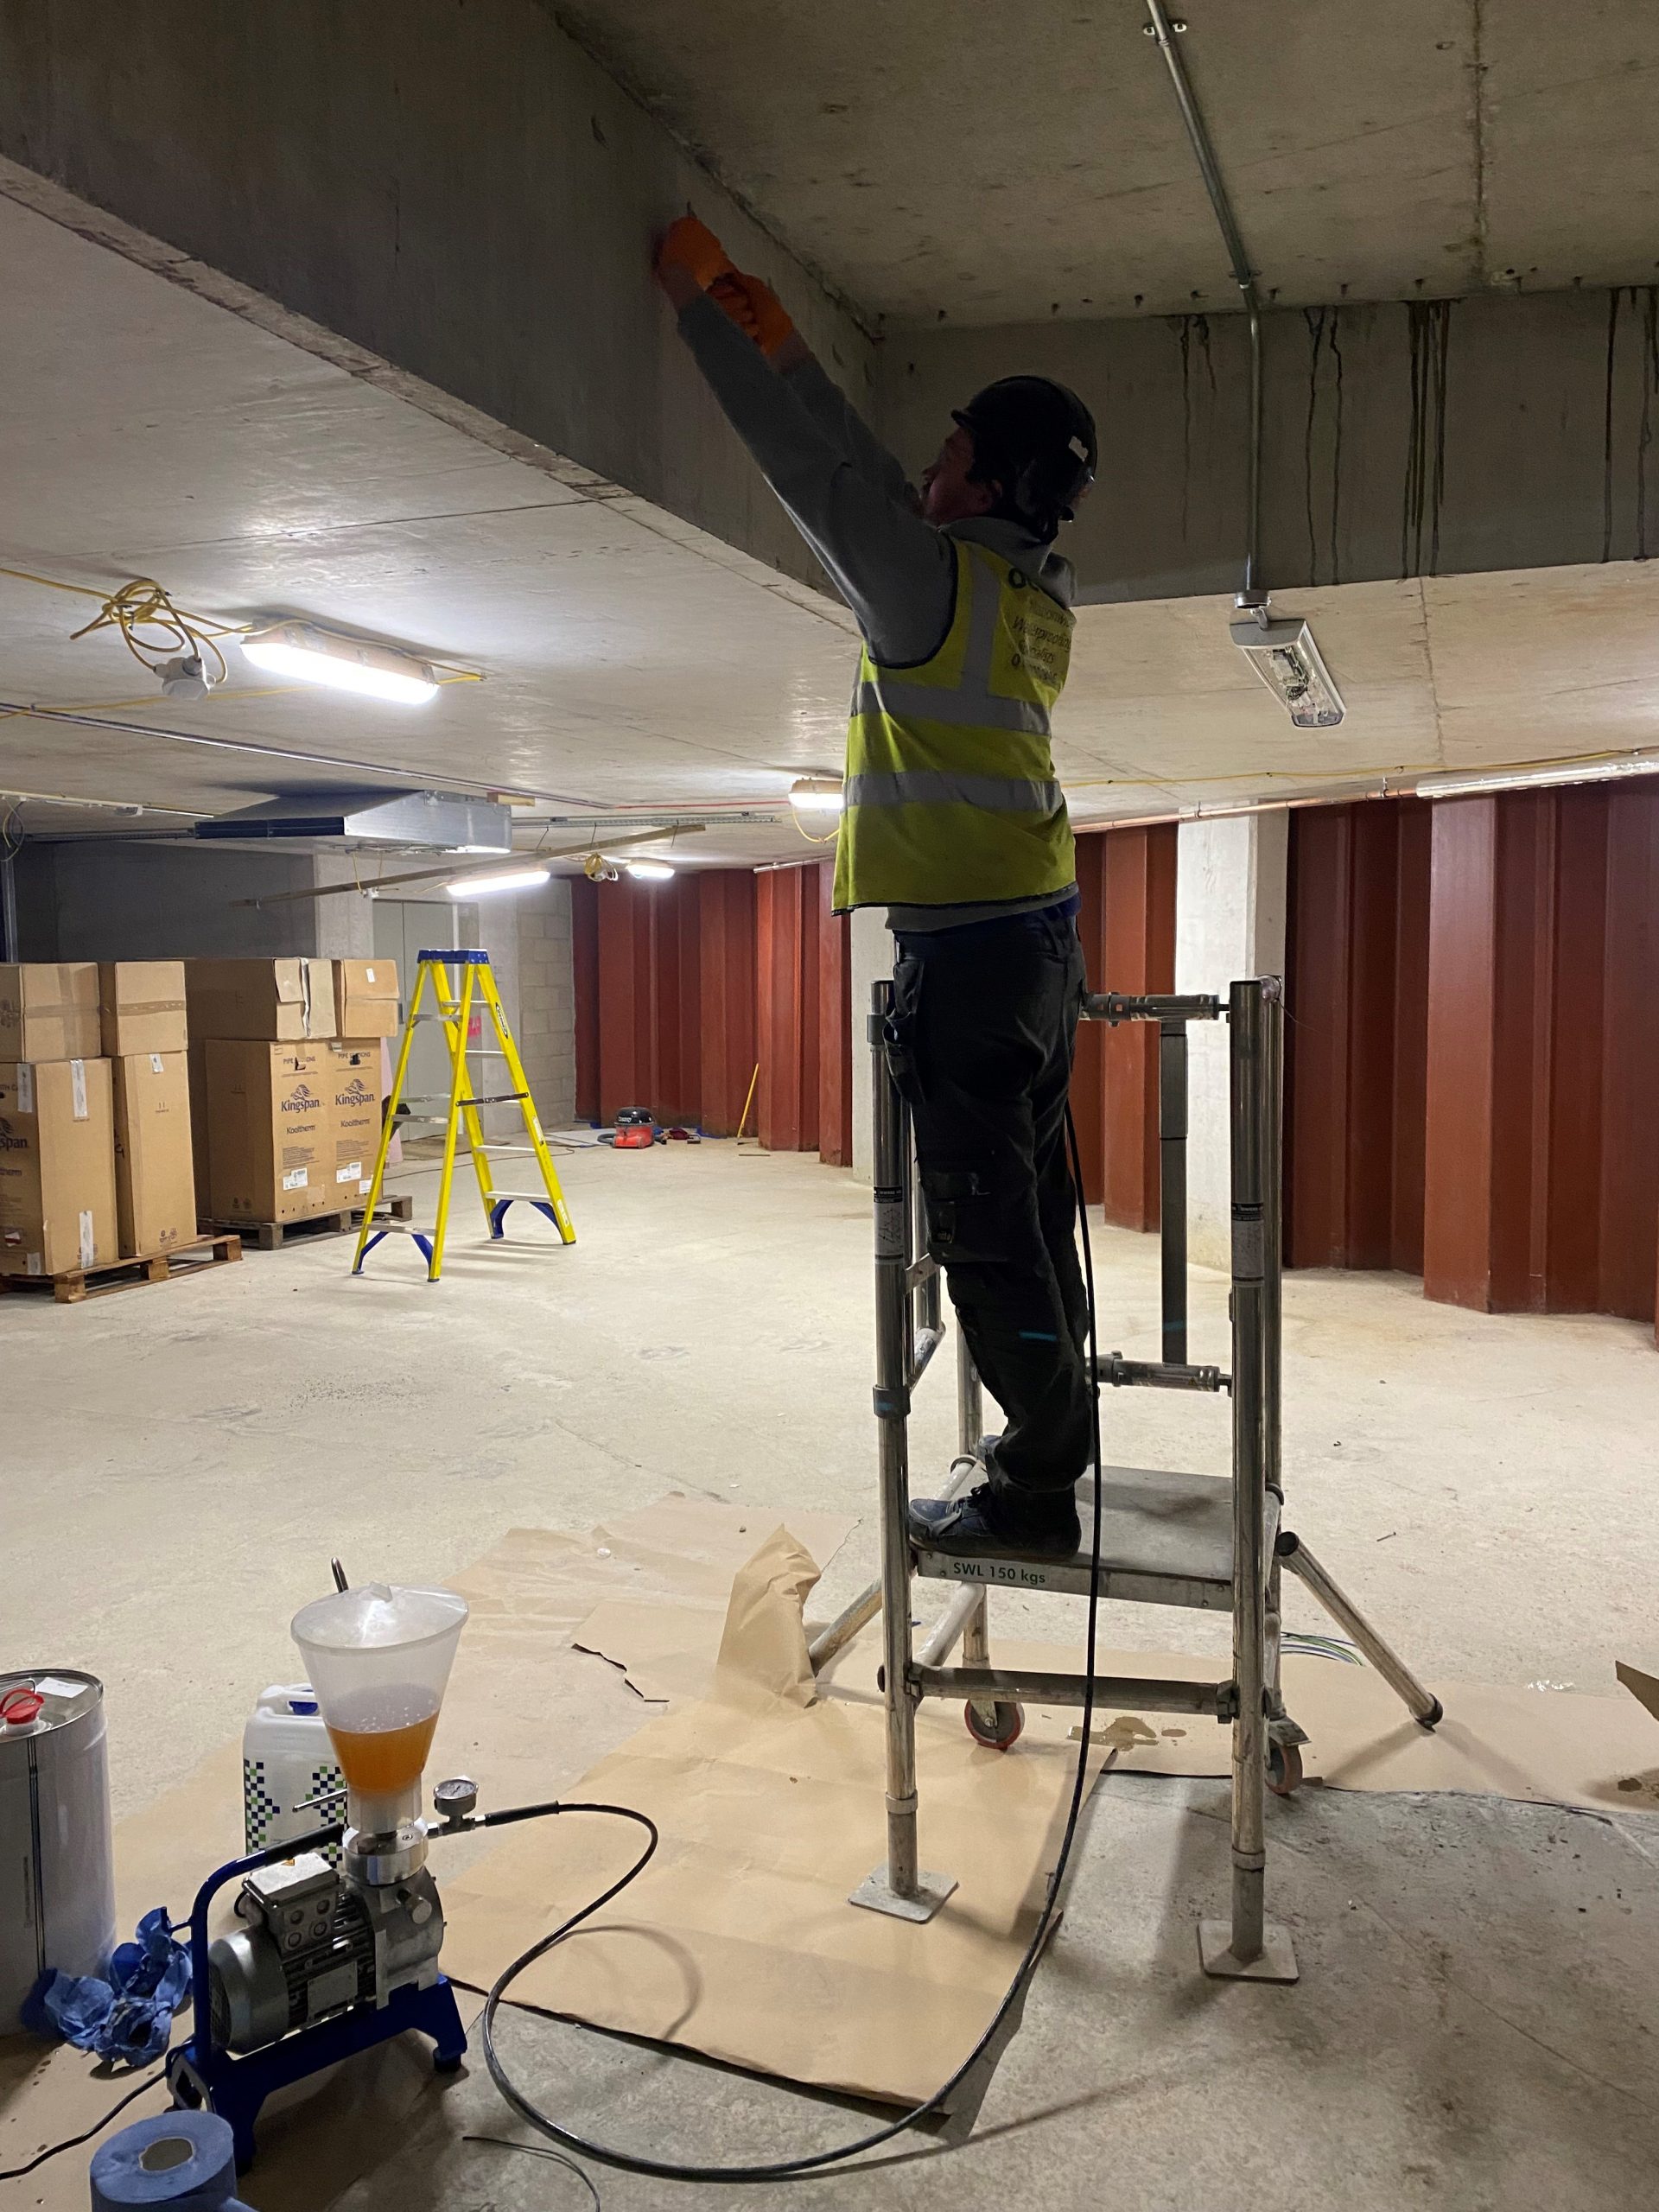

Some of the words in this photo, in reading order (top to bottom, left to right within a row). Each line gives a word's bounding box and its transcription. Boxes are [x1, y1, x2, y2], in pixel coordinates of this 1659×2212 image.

[281, 1099, 320, 1113] Kingspan
[335, 1093, 375, 1107] Kingspan
[287, 1125, 315, 1135] Kooltherm
[953, 1561, 984, 1577] SWL
[989, 1566, 1016, 1580] 150
[1021, 1569, 1046, 1585] kgs
